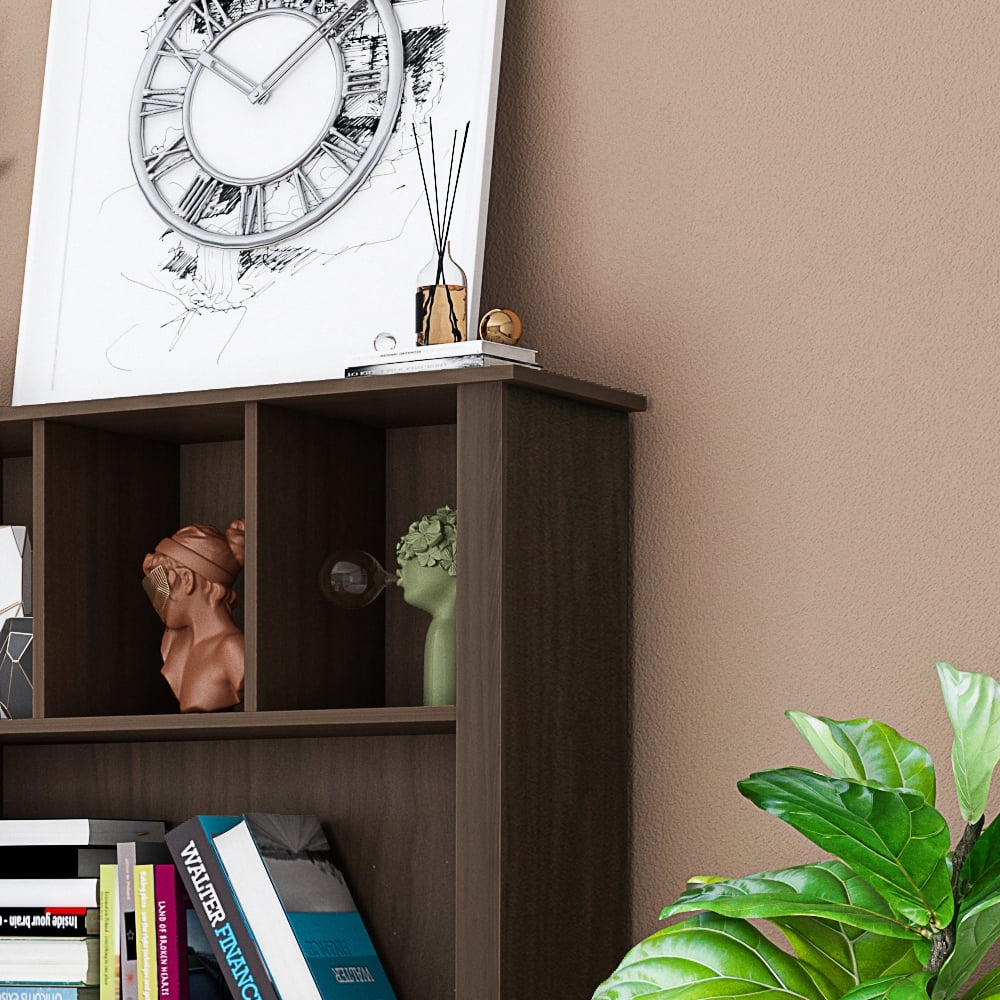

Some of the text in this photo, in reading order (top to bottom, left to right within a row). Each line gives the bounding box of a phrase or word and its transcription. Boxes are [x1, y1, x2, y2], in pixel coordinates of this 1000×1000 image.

[180, 840, 226, 928] WALTER
[9, 914, 31, 929] brain
[31, 912, 52, 927] your
[52, 914, 78, 929] Inside
[158, 901, 170, 996] LAND OF BROKEN HEARTS
[331, 966, 375, 983] WALTER
